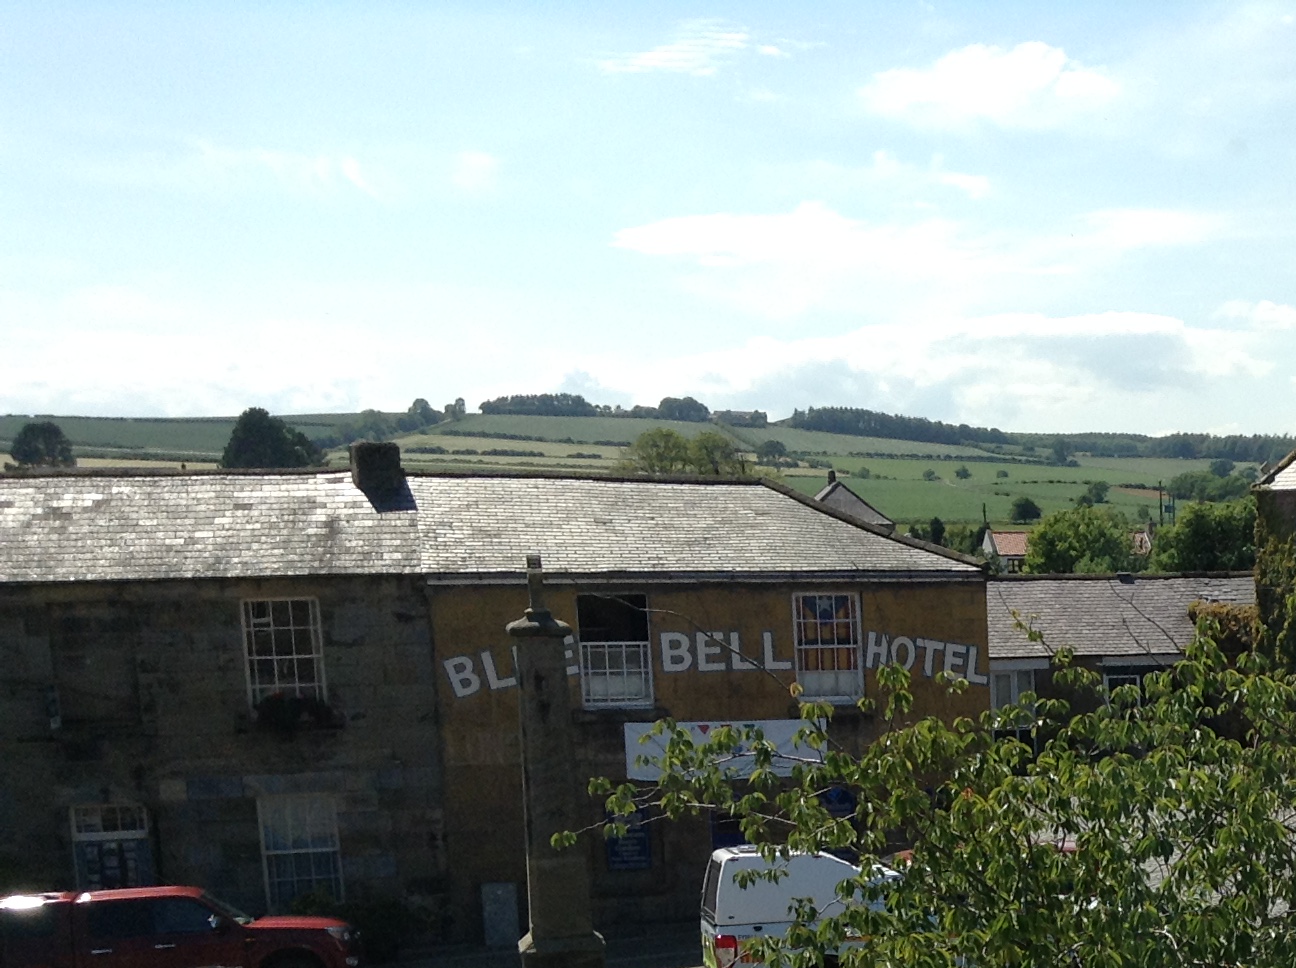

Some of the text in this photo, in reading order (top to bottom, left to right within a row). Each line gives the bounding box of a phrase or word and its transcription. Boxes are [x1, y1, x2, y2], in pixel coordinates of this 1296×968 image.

[443, 631, 988, 697] BLE BELL HOTEL
